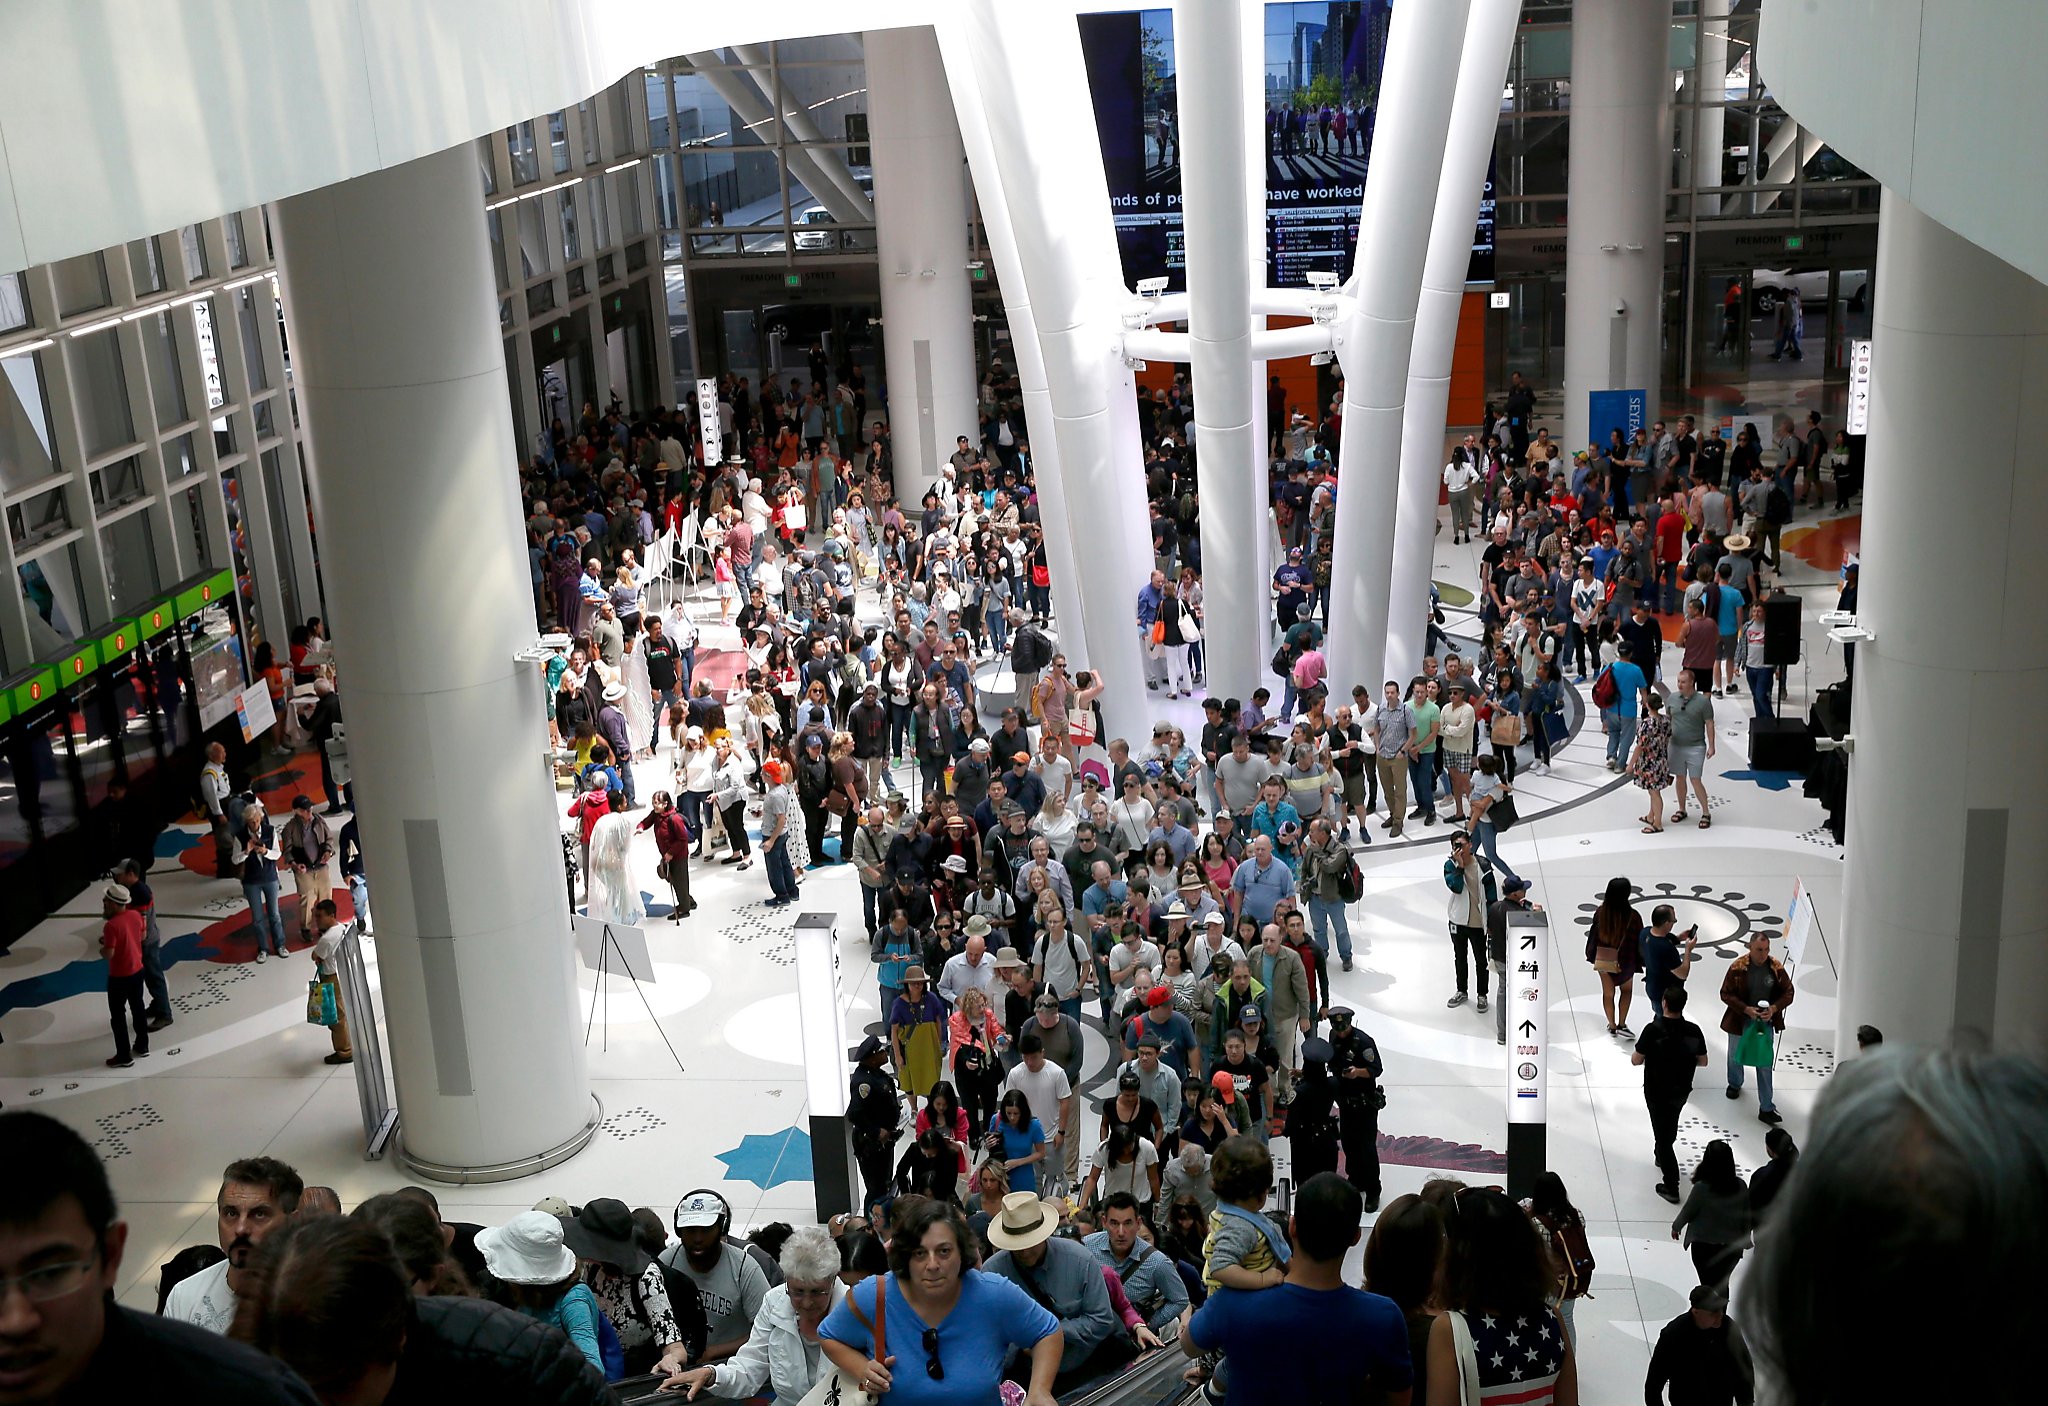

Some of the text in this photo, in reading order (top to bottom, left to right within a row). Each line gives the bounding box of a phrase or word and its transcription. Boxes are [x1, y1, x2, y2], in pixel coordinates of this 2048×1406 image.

[1145, 192, 1161, 205] of
[1266, 184, 1363, 200] have worked
[1734, 234, 1782, 246] FREMONT
[1808, 232, 1842, 242] STREET
[1532, 243, 1566, 253] FREMO
[739, 272, 782, 282] FREMONT
[804, 271, 836, 280] STREET
